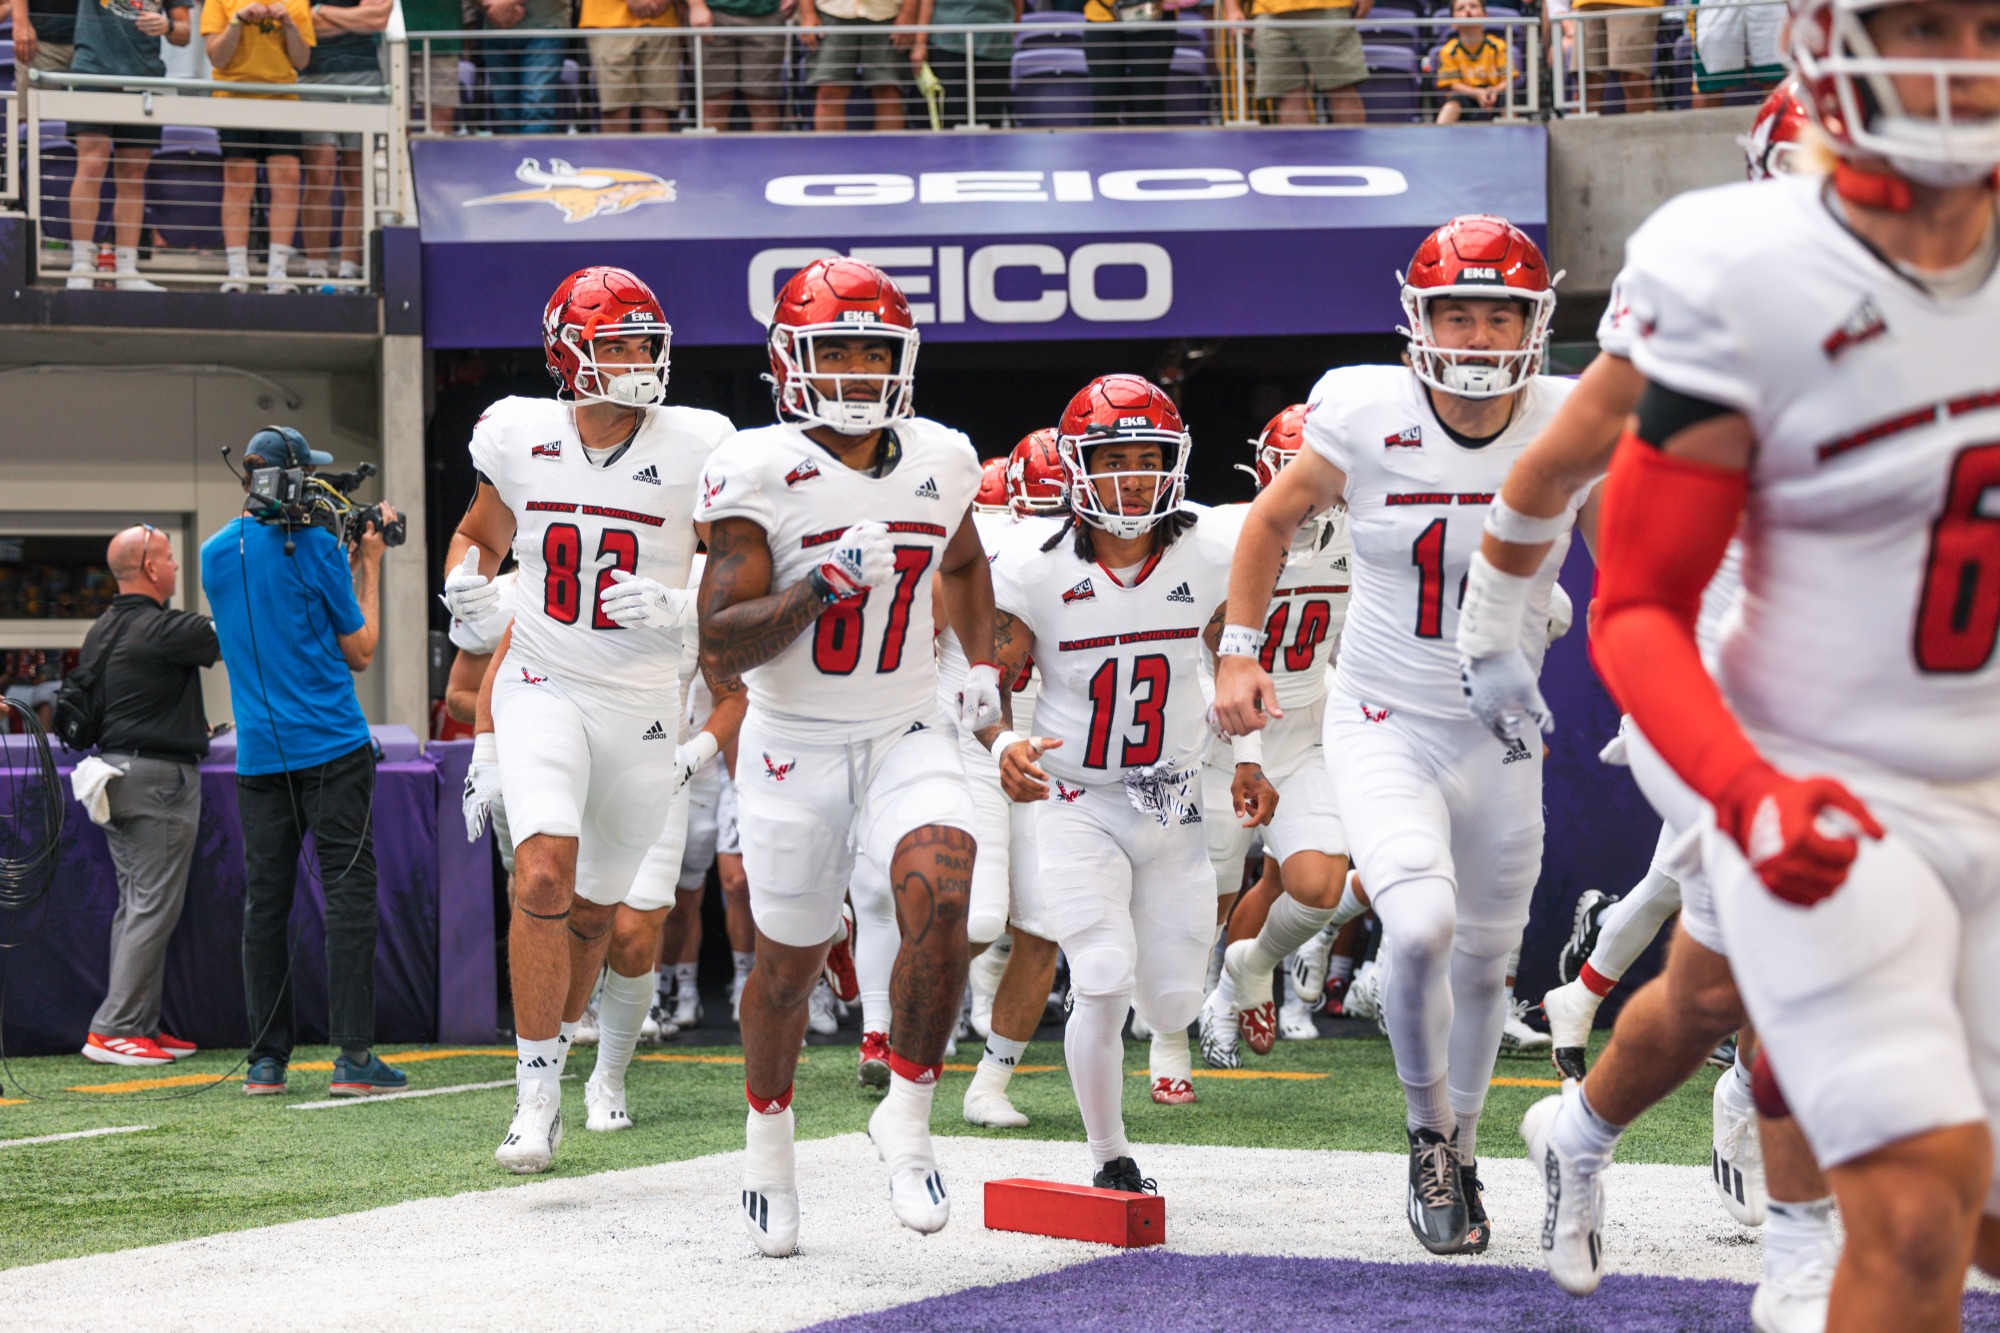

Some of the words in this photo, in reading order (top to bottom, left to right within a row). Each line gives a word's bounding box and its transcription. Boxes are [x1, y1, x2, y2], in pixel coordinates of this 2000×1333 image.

[764, 164, 1408, 206] GEICO
[1463, 267, 1496, 279] EKG
[631, 312, 653, 322] EKG
[843, 310, 875, 322] EKG
[1119, 416, 1147, 427] EKG
[632, 474, 662, 486] adidas
[525, 501, 580, 513] EASTERN
[582, 504, 666, 527] WASHINGTON
[880, 521, 946, 538] ASHINGTON
[835, 552, 864, 580] adidas
[542, 522, 639, 630] 82
[1166, 593, 1195, 603] adidas
[1059, 636, 1116, 651] EASTERN
[1119, 627, 1200, 645] WASHINGTON
[1259, 600, 1330, 673] 10
[1082, 653, 1171, 769] 13
[642, 732, 667, 741] adidas
[1502, 751, 1532, 764] adidas
[1180, 814, 1203, 825] adidas
